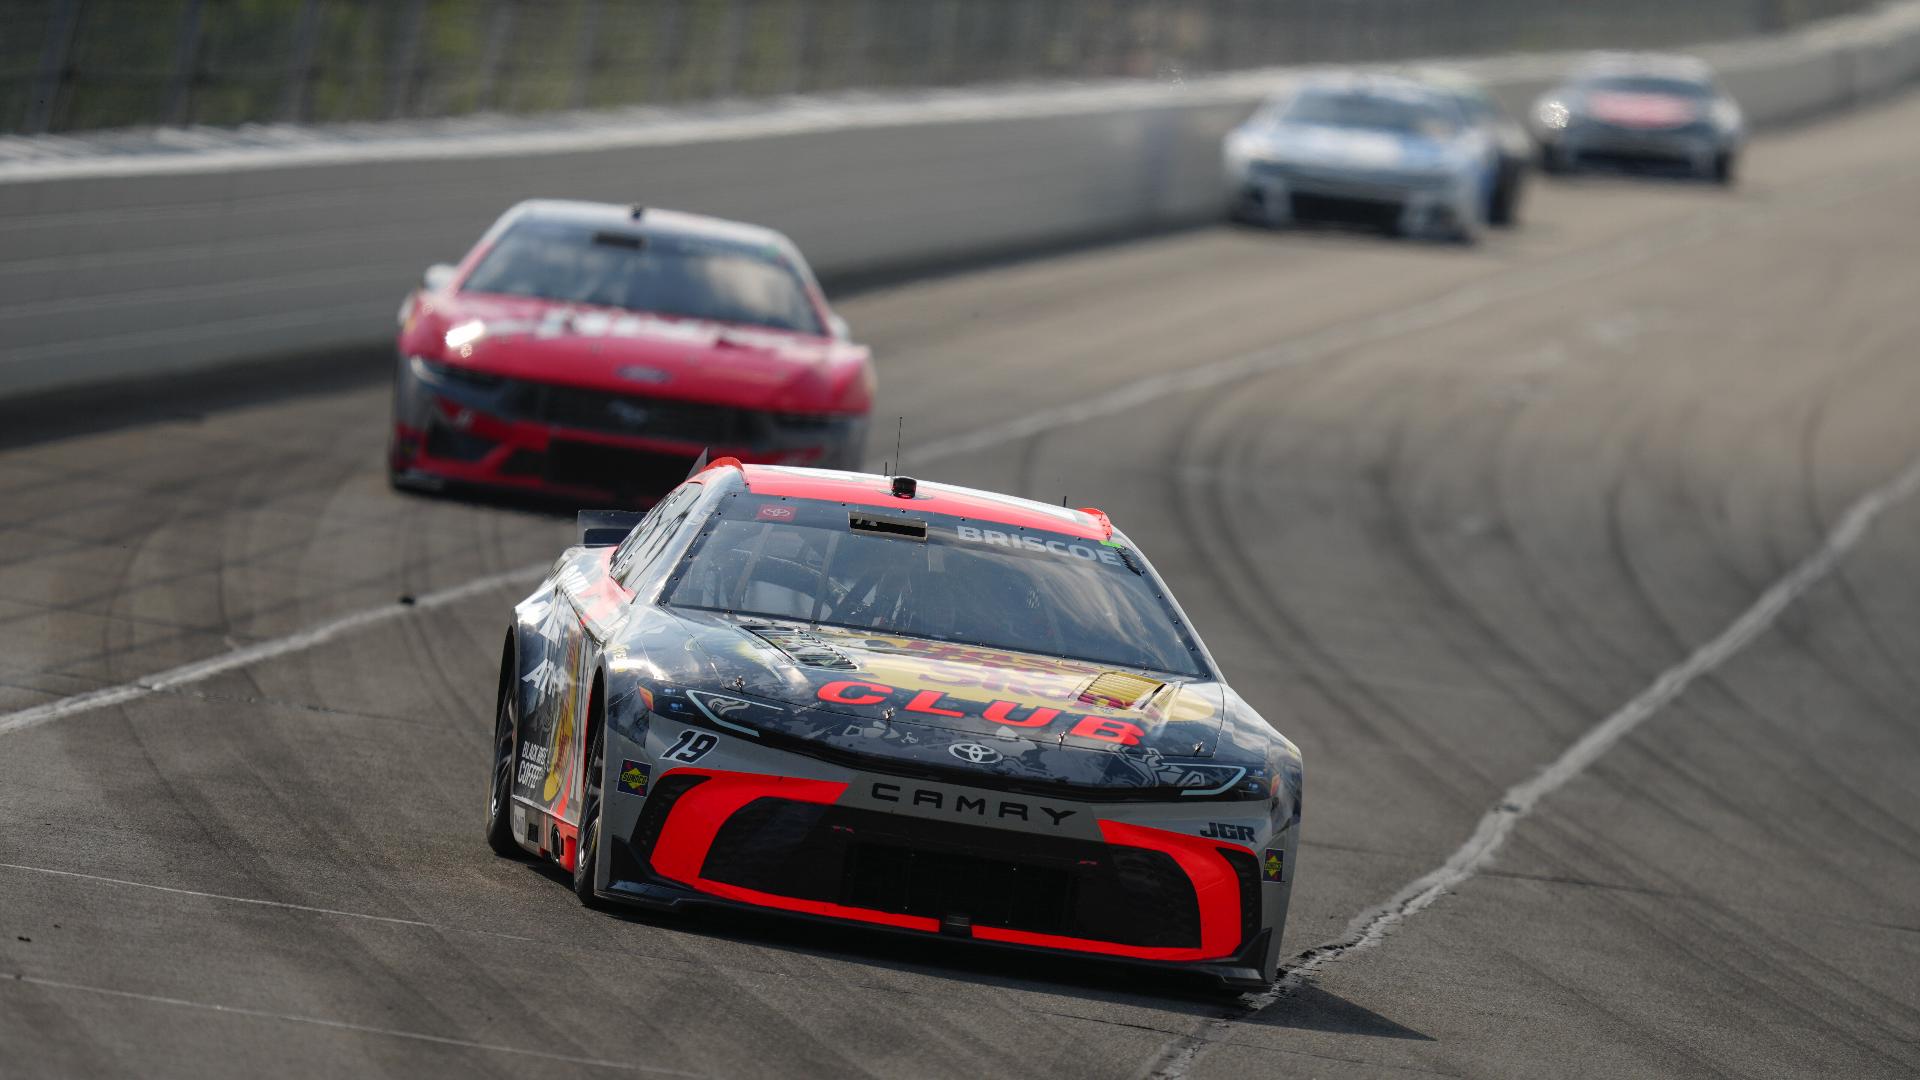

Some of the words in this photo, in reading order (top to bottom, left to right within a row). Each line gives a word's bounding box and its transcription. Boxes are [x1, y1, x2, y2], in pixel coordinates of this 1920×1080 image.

[956, 525, 1121, 566] BRISCOE
[817, 681, 1145, 745] CLUB
[661, 730, 719, 763] 19
[871, 782, 1077, 825] CAMRY
[1200, 822, 1257, 843] JGR
